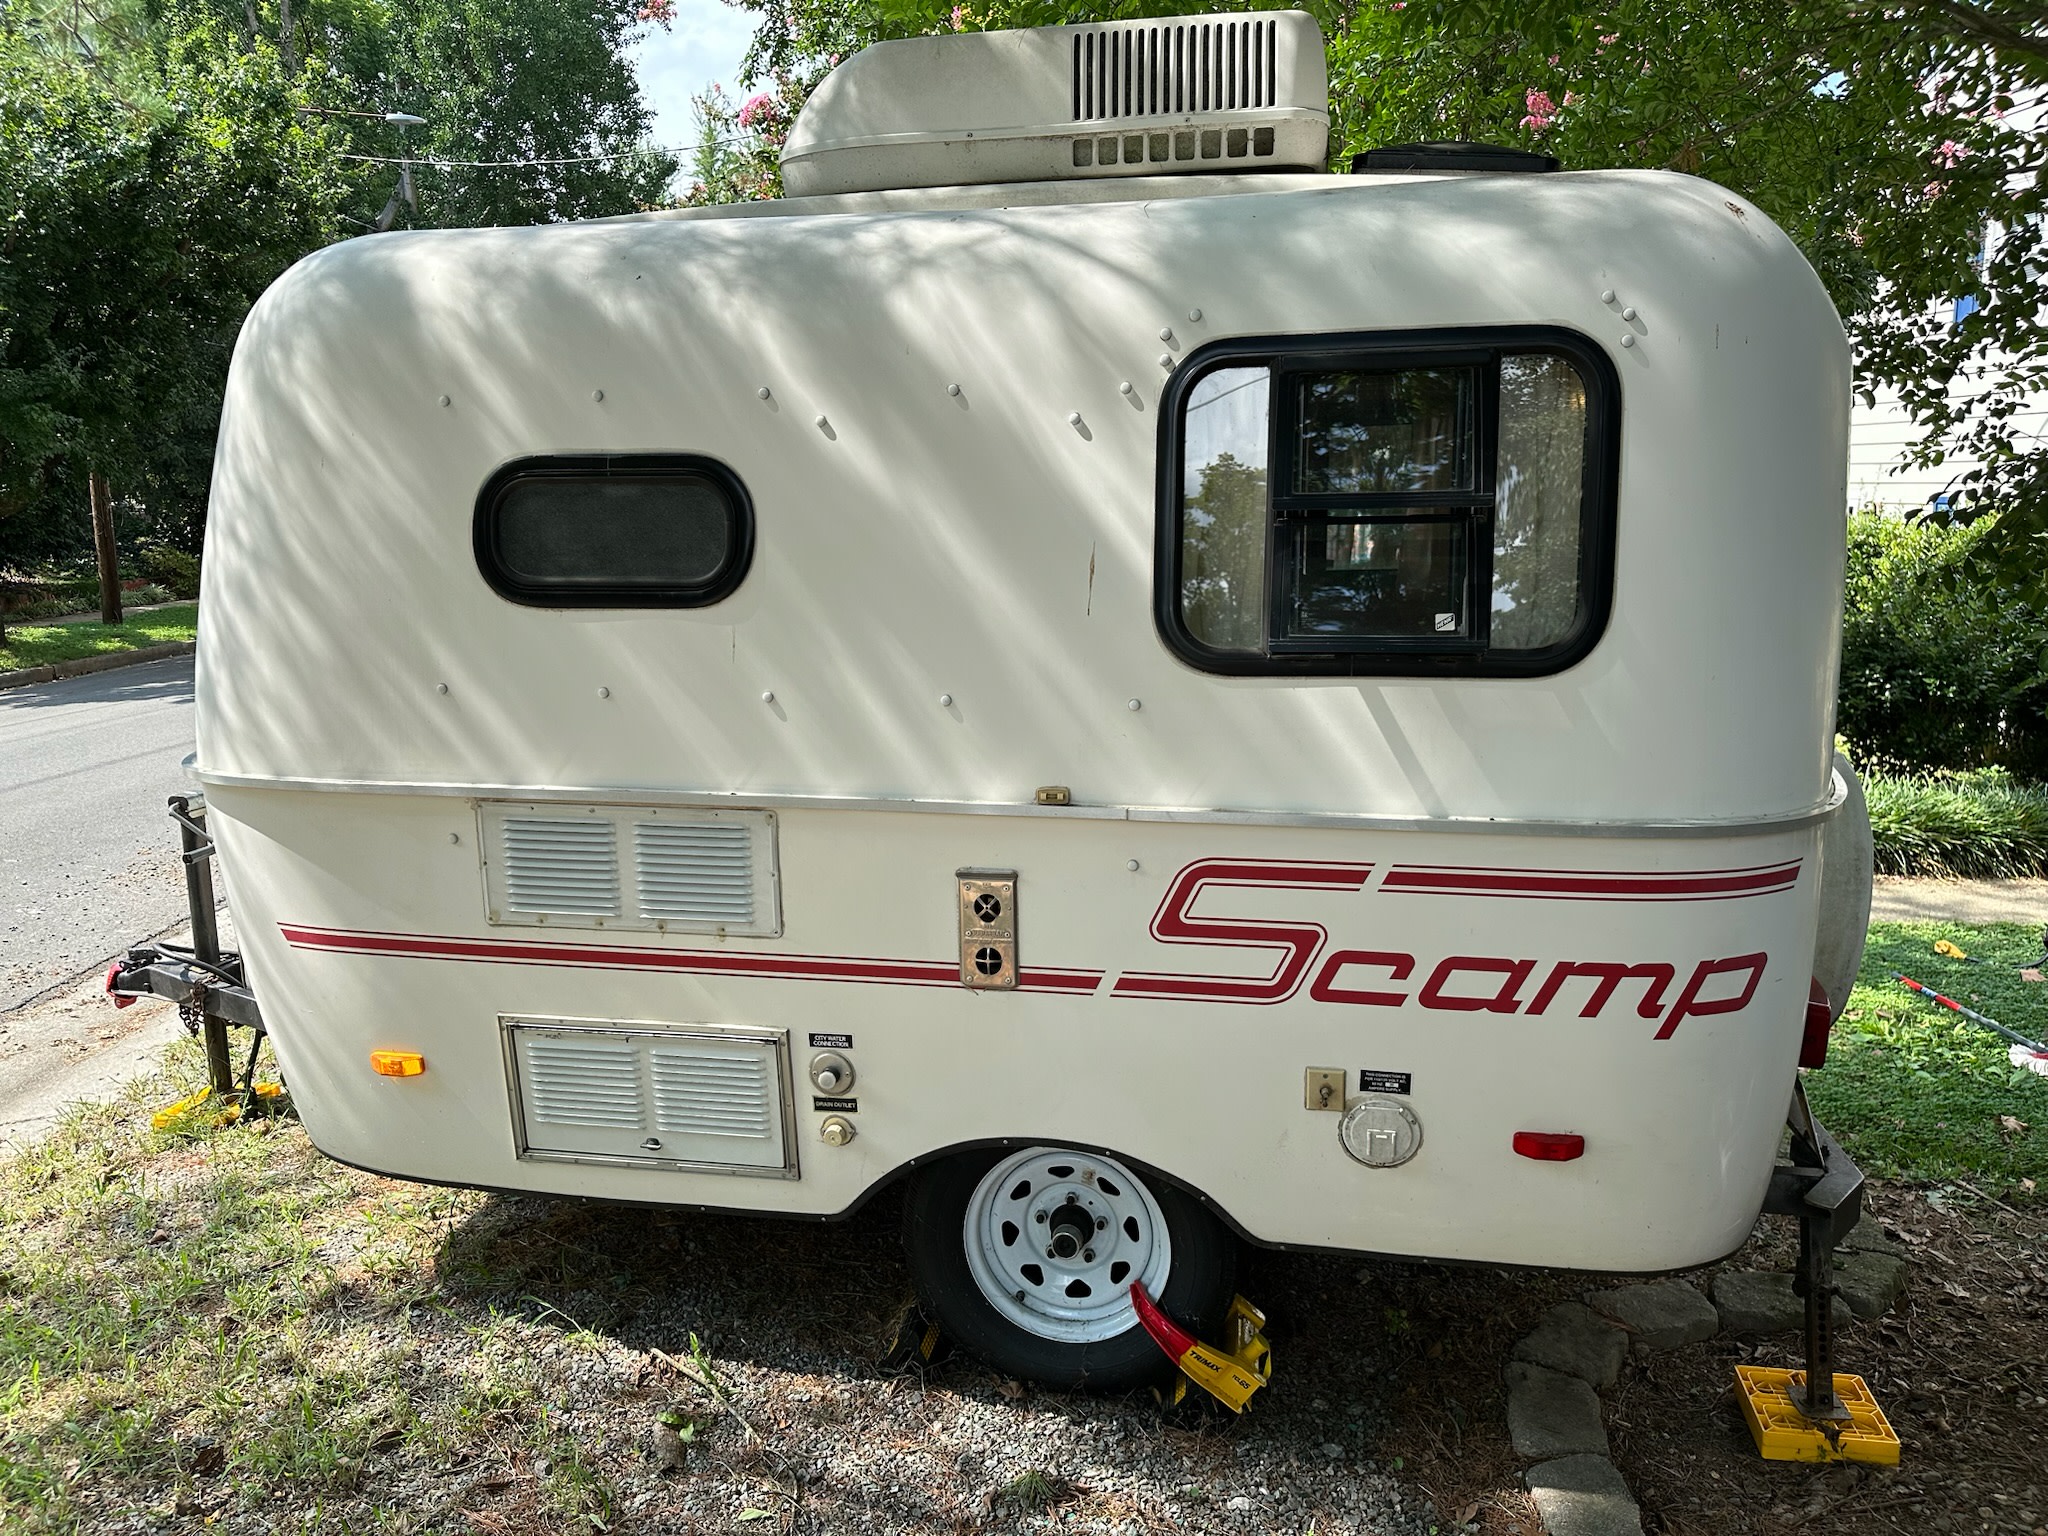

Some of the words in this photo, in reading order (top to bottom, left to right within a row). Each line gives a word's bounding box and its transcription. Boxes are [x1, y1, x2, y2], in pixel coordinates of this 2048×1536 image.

[1149, 857, 1769, 1041] Scamp
[813, 1040, 849, 1048] CONNECTION
[1189, 1351, 1222, 1372] TRIMAX
